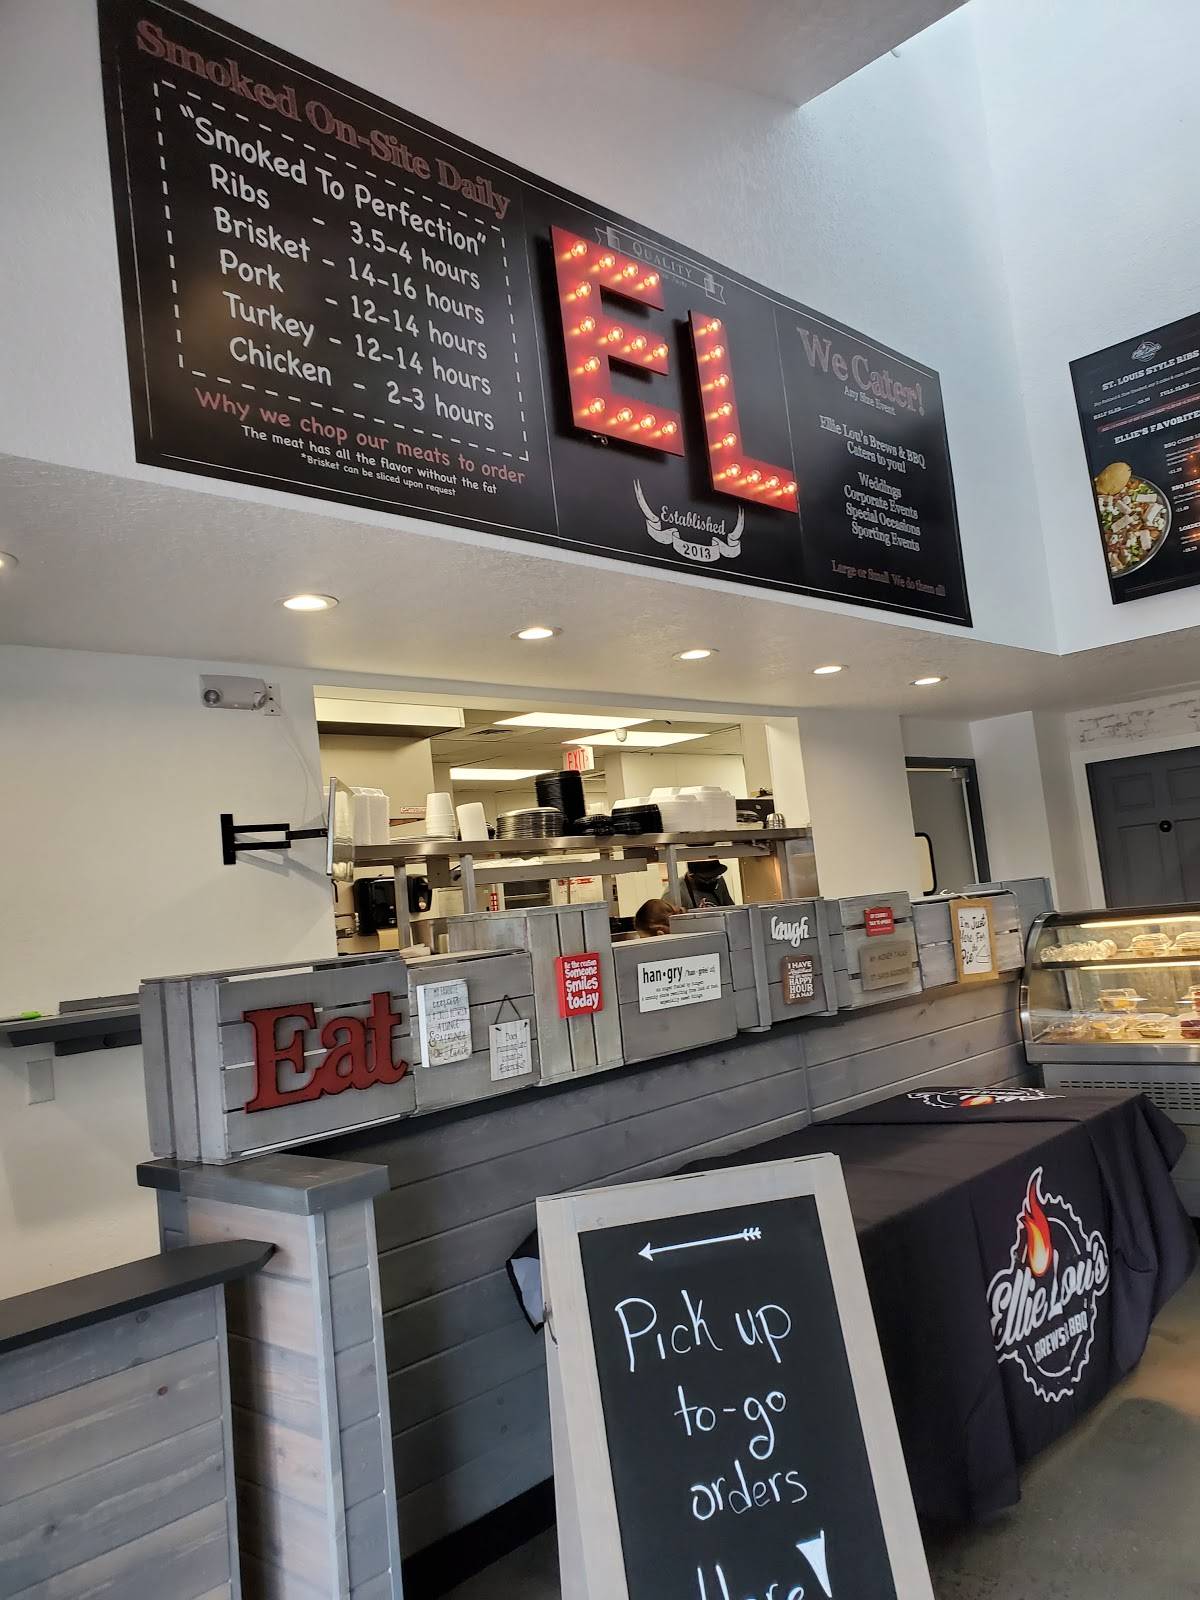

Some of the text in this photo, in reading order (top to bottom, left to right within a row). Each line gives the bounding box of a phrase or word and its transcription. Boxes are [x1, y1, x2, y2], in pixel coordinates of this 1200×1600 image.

[136, 20, 511, 220] Smoked On-Site Daily
[315, 166, 345, 200] To
[209, 163, 270, 209] Ribs
[349, 221, 412, 264] 3.5-4
[421, 248, 481, 290] hours
[213, 206, 310, 262] Brisket
[348, 256, 417, 300] 14-16
[425, 283, 485, 325] hours
[632, 241, 692, 278] QUALITY
[219, 249, 284, 293] Pork
[351, 295, 420, 338] 12-14
[428, 319, 488, 360] hours
[222, 290, 315, 347] Turkey
[355, 333, 423, 375] 12-14
[432, 356, 492, 396] hours
[229, 336, 332, 387] Chicken
[386, 380, 425, 411] 2-3
[434, 393, 495, 431] hours
[796, 327, 925, 417] We Cater!
[1102, 380, 1117, 391] ST.
[1117, 369, 1145, 385] LOUIS
[1145, 358, 1176, 375] STYLE
[1176, 349, 1200, 364] RIBS
[844, 385, 859, 401] Any
[194, 386, 527, 485] Why we chop our meats to order
[819, 414, 926, 470] Ellie Lou's Brews & BBQ
[1114, 427, 1149, 445] ELLIE'S
[1149, 409, 1200, 433] FAVORITE
[240, 424, 497, 495] The meat has all the flavor without the fat
[846, 440, 906, 474] Caters to you!
[343, 464, 359, 475] can
[362, 468, 374, 478] be
[376, 471, 400, 484] sliced
[403, 479, 424, 490] upon
[426, 482, 456, 497] request
[857, 471, 902, 500] Weddings
[660, 505, 726, 535] Established
[844, 484, 918, 520] Corporate Events
[845, 502, 921, 536] Special Occasions
[683, 543, 711, 559] 2013
[851, 521, 920, 552] Sporting Events
[831, 560, 857, 578] Large
[857, 569, 867, 578] or
[566, 749, 585, 770] EXIT
[771, 916, 809, 948] laugh
[570, 960, 580, 968] the
[580, 959, 597, 967] reason
[789, 976, 813, 986] HAPPY
[792, 960, 812, 969] HAVE
[566, 990, 599, 1010] today
[790, 983, 814, 994] HOUR
[240, 991, 408, 1114] Eat
[990, 1241, 1108, 1351] Ellie Lou's
[614, 1289, 792, 1373] Pick up
[1034, 1326, 1066, 1362] BREWS
[1068, 1310, 1088, 1337] BBQ
[674, 1385, 787, 1460] to-go
[690, 1459, 808, 1521] orders
